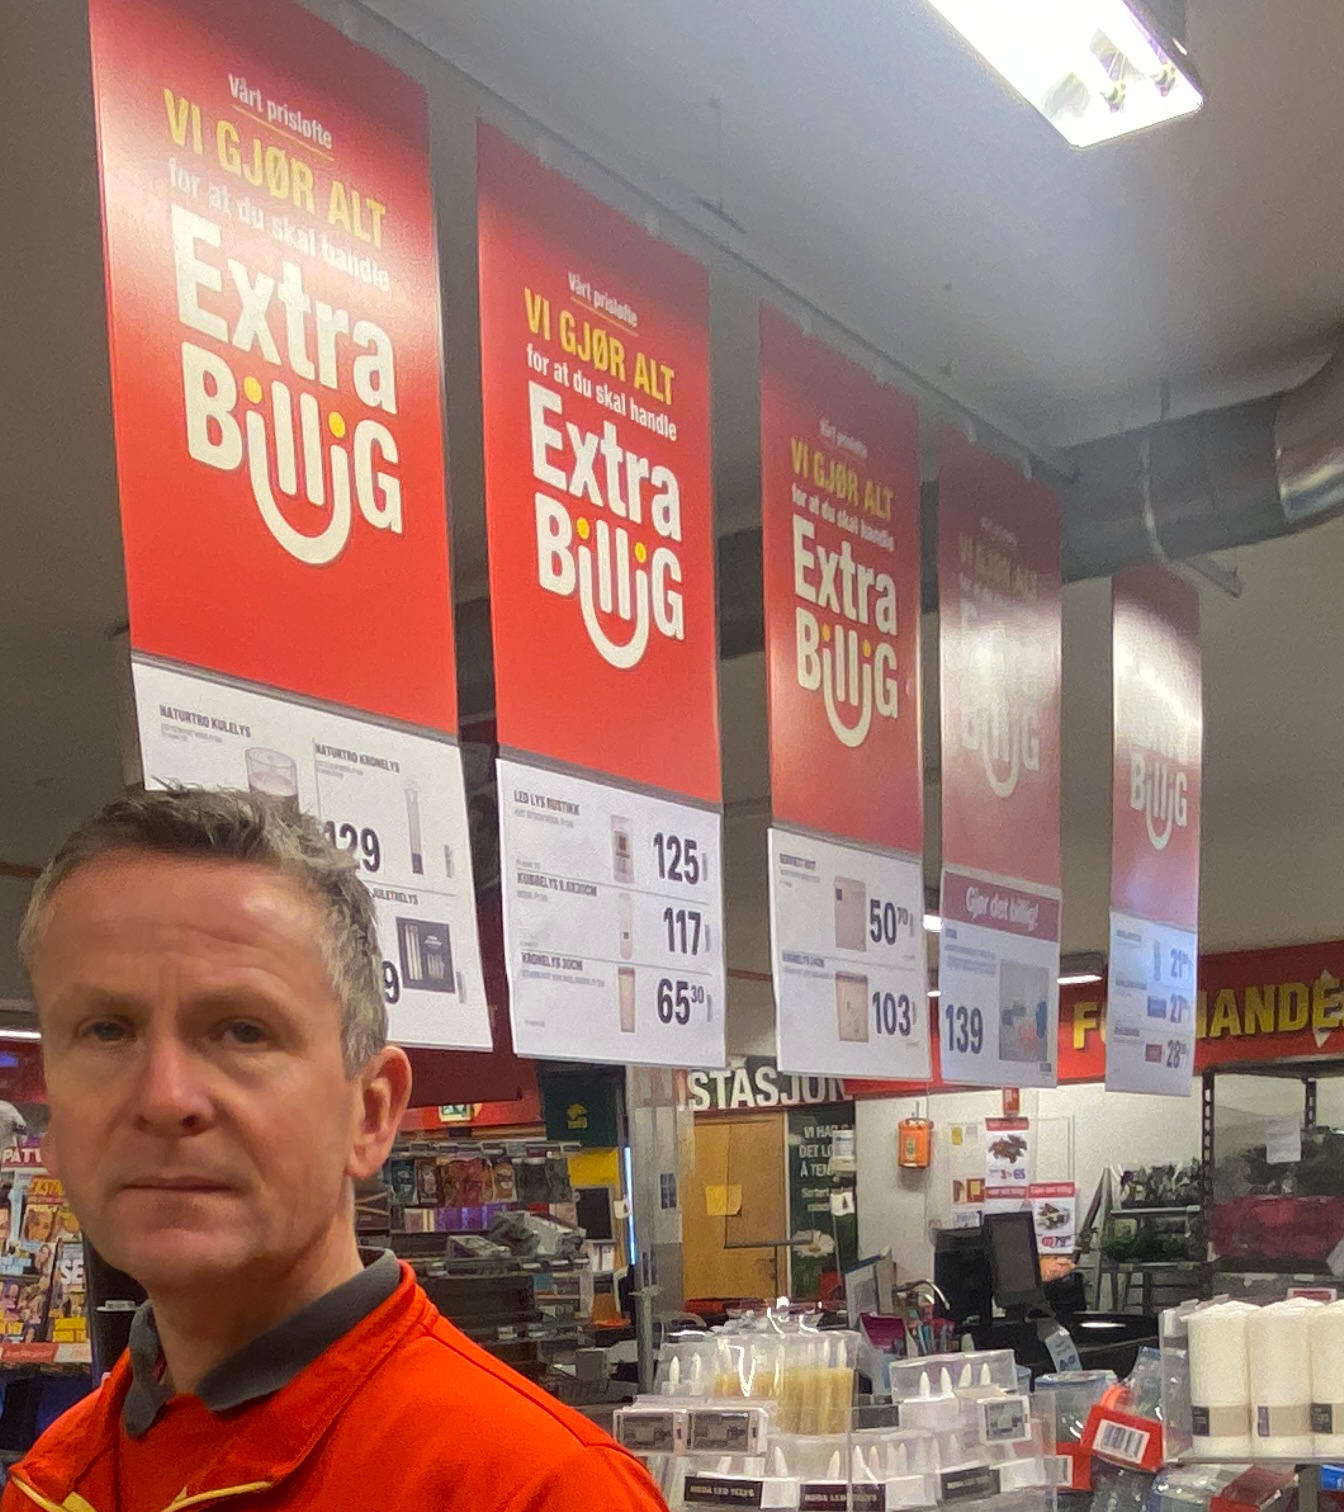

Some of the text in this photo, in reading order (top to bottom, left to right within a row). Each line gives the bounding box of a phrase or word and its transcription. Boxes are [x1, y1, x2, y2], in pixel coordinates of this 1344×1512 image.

[229, 73, 334, 150] Vårt prisløfte
[164, 89, 387, 249] VI GJØR ALT
[169, 157, 202, 199] for
[208, 179, 231, 216] at
[236, 194, 266, 232] du
[272, 212, 316, 255] skal
[171, 204, 398, 415] Extra
[524, 288, 675, 405] VI GJØR ALT
[527, 343, 677, 442] for at du skal handle
[528, 380, 682, 543] Extra
[791, 437, 810, 479] VI
[863, 482, 895, 522] ALT
[792, 513, 898, 637] Extra
[653, 831, 700, 886] 125
[663, 906, 702, 956] 117
[869, 898, 897, 946] 50
[657, 977, 690, 1026] 65
[872, 991, 912, 1037] 103
[945, 1004, 984, 1055] 139
